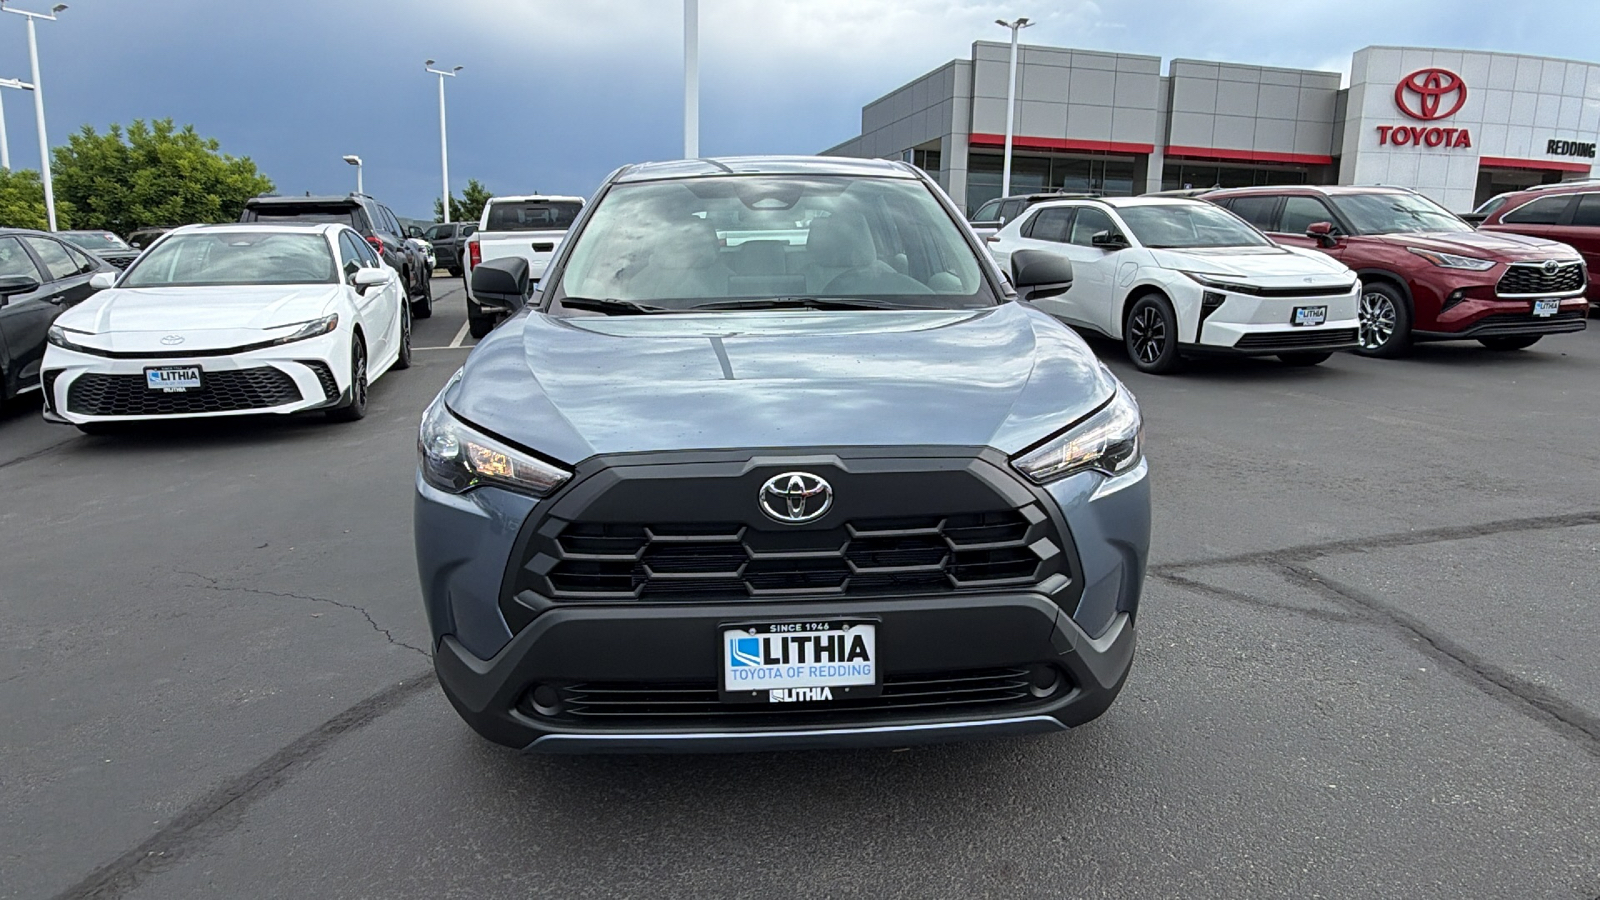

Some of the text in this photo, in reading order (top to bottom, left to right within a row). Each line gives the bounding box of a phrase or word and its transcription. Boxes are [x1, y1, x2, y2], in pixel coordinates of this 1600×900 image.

[1376, 126, 1472, 149] TOYOTA
[1546, 139, 1597, 158] REDDING
[160, 371, 199, 381] LITHIA
[769, 622, 830, 633] SINCE 1946
[762, 634, 871, 665] LITHIA
[731, 664, 871, 680] TOYOTA OF REDDING
[783, 686, 833, 702] LITHIA
